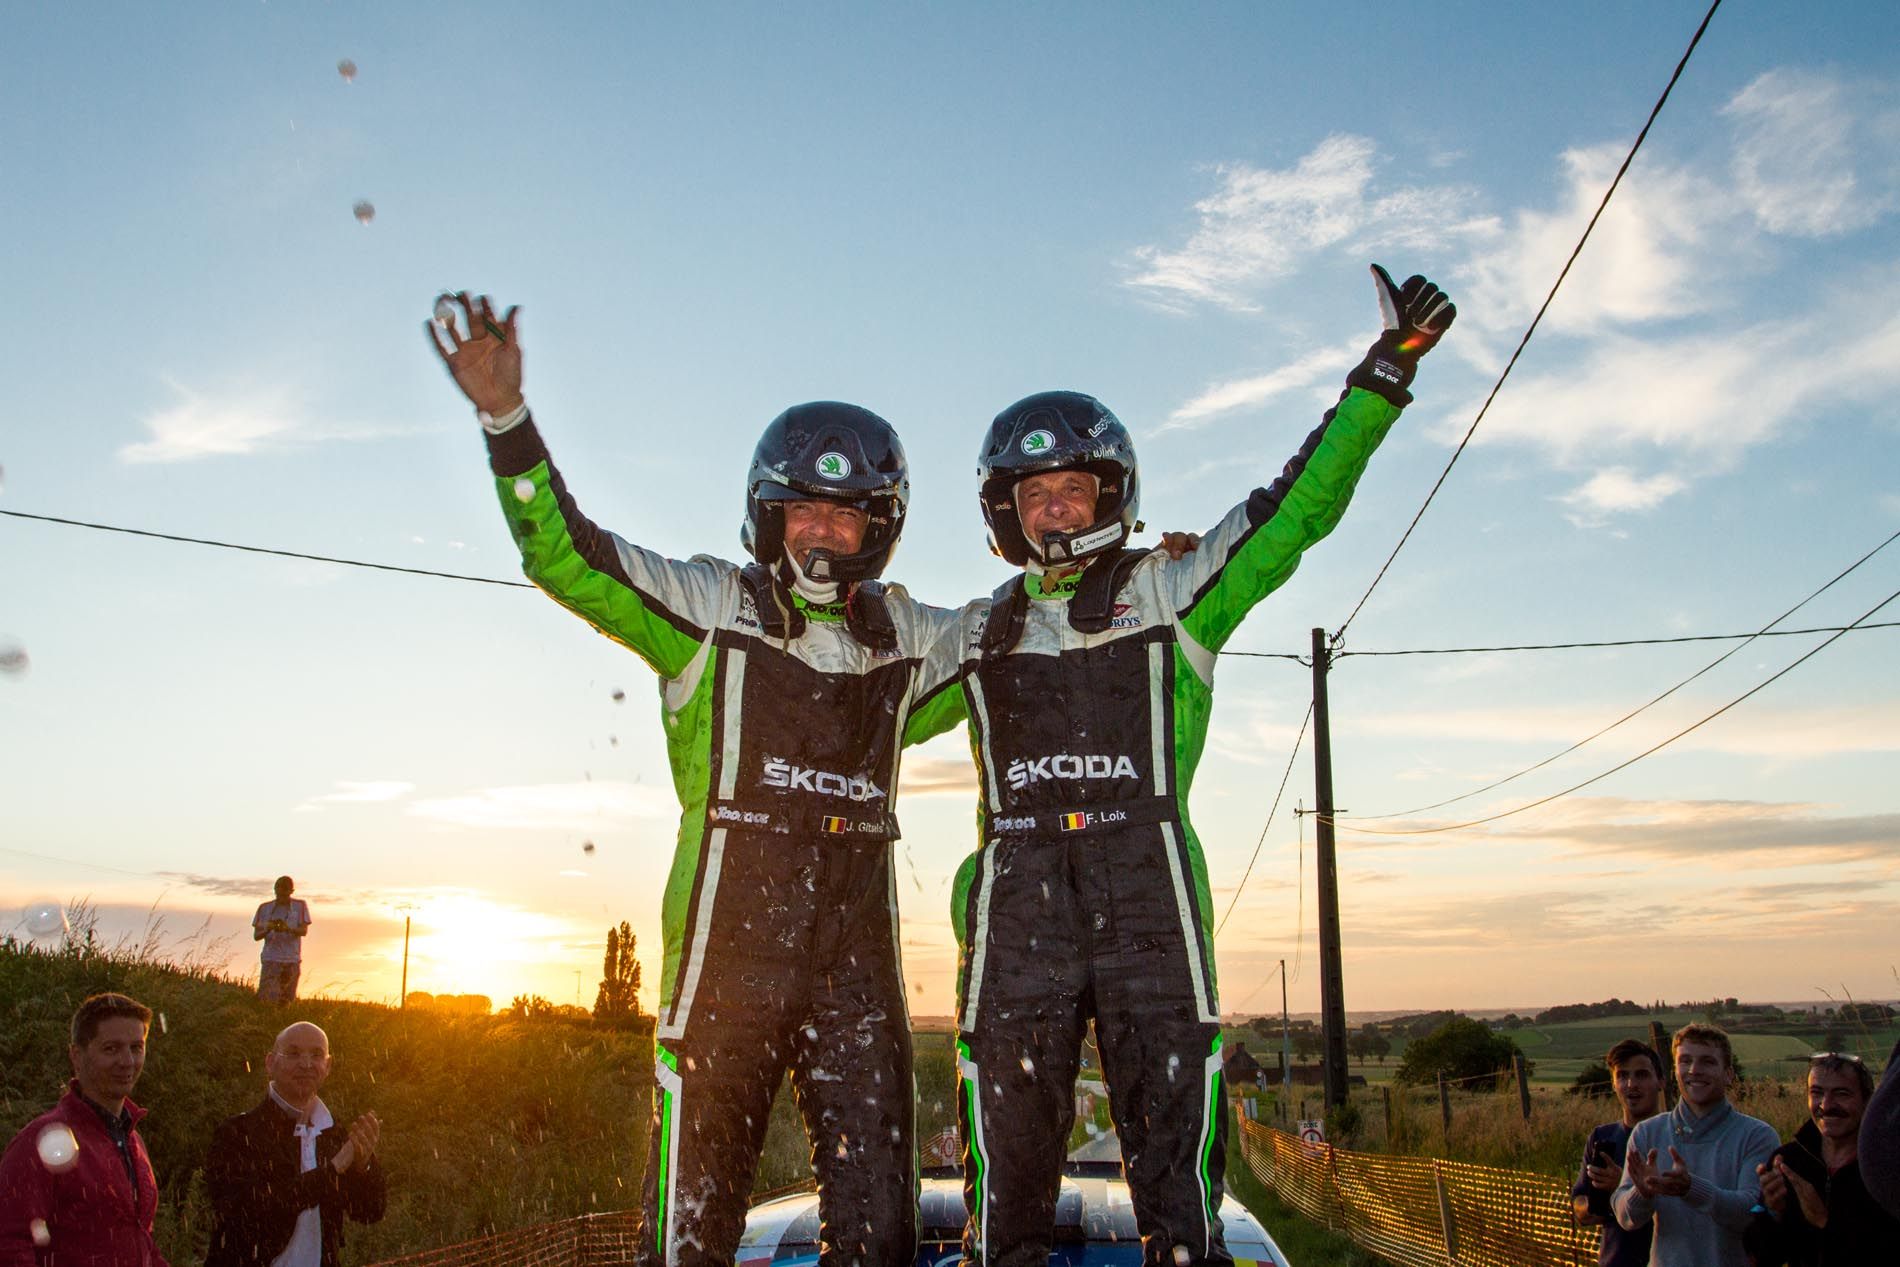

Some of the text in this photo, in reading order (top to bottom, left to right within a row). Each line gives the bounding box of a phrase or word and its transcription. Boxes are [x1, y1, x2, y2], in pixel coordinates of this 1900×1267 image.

[762, 757, 887, 802] ŠKODA
[1007, 753, 1139, 791] ŠKODA
[846, 821, 855, 832] J.
[1086, 810, 1127, 825] F. Loix
